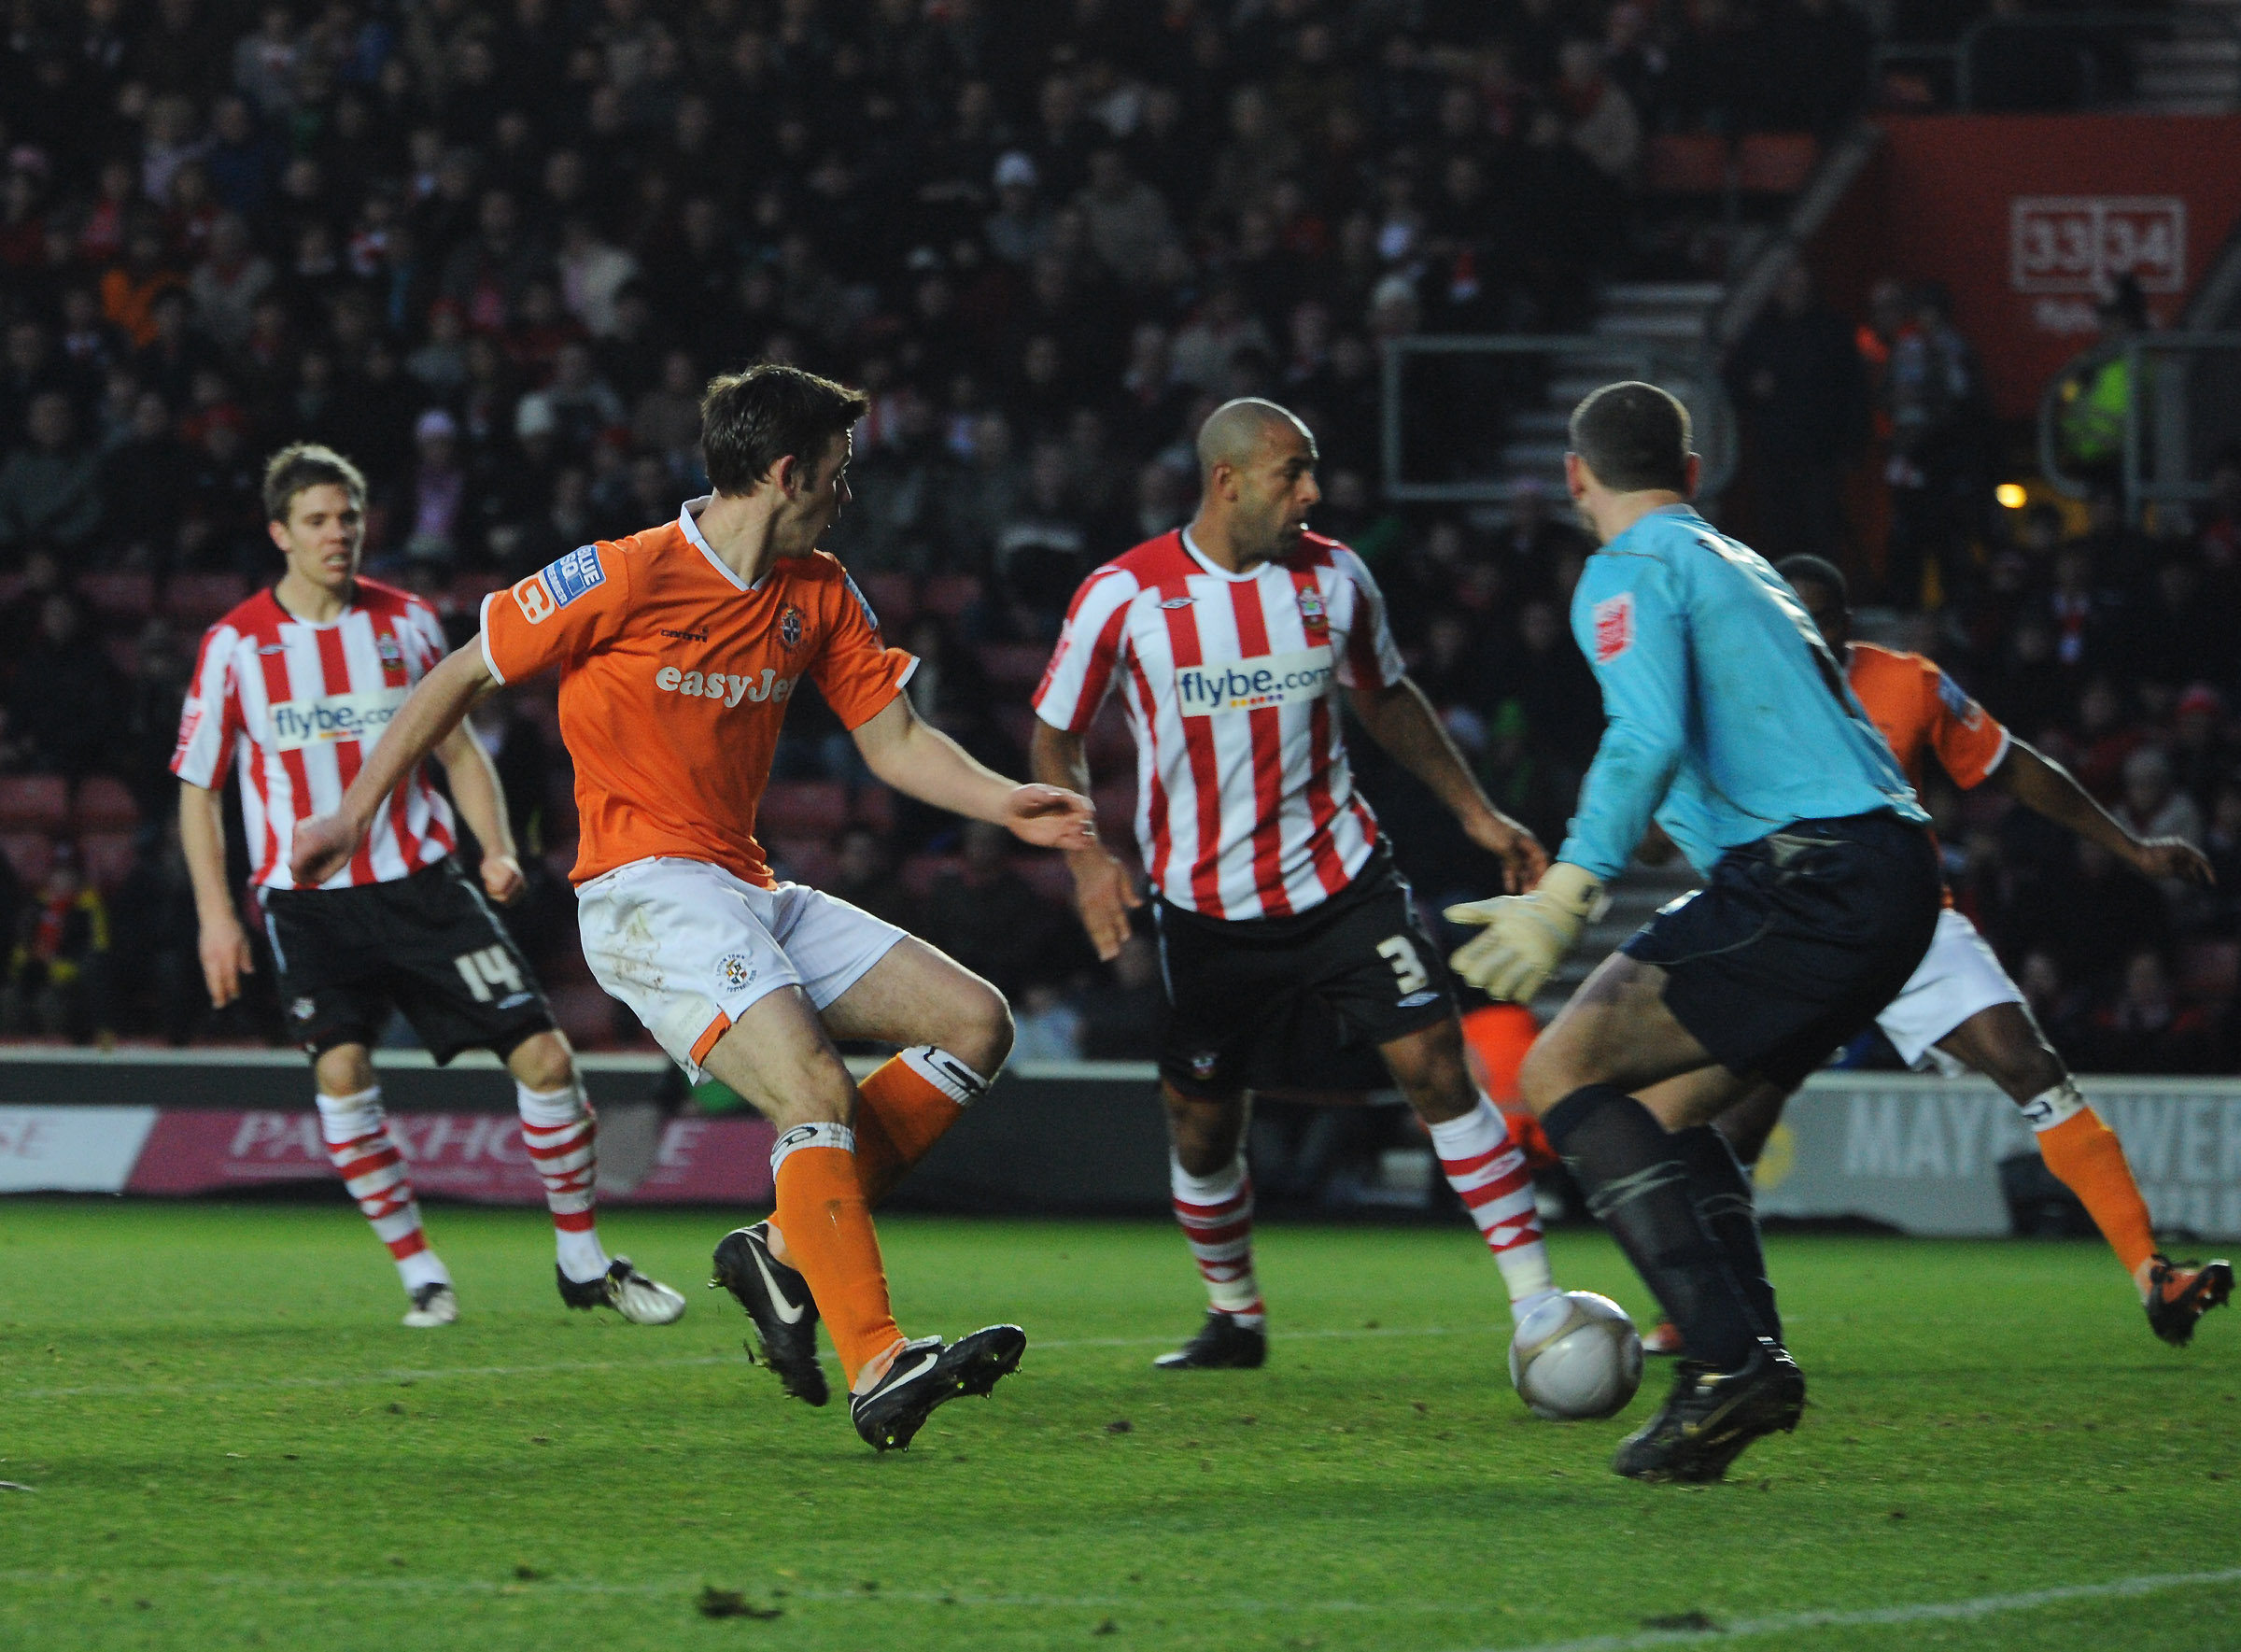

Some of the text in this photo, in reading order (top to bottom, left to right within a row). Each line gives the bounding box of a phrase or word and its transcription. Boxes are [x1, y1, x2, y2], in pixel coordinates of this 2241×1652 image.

[2023, 218, 2087, 269] 33
[560, 553, 579, 580] SQ
[577, 546, 600, 586] BLUE
[276, 705, 398, 739] flybe.co
[454, 944, 525, 1002] 14
[1376, 935, 1428, 995] 3
